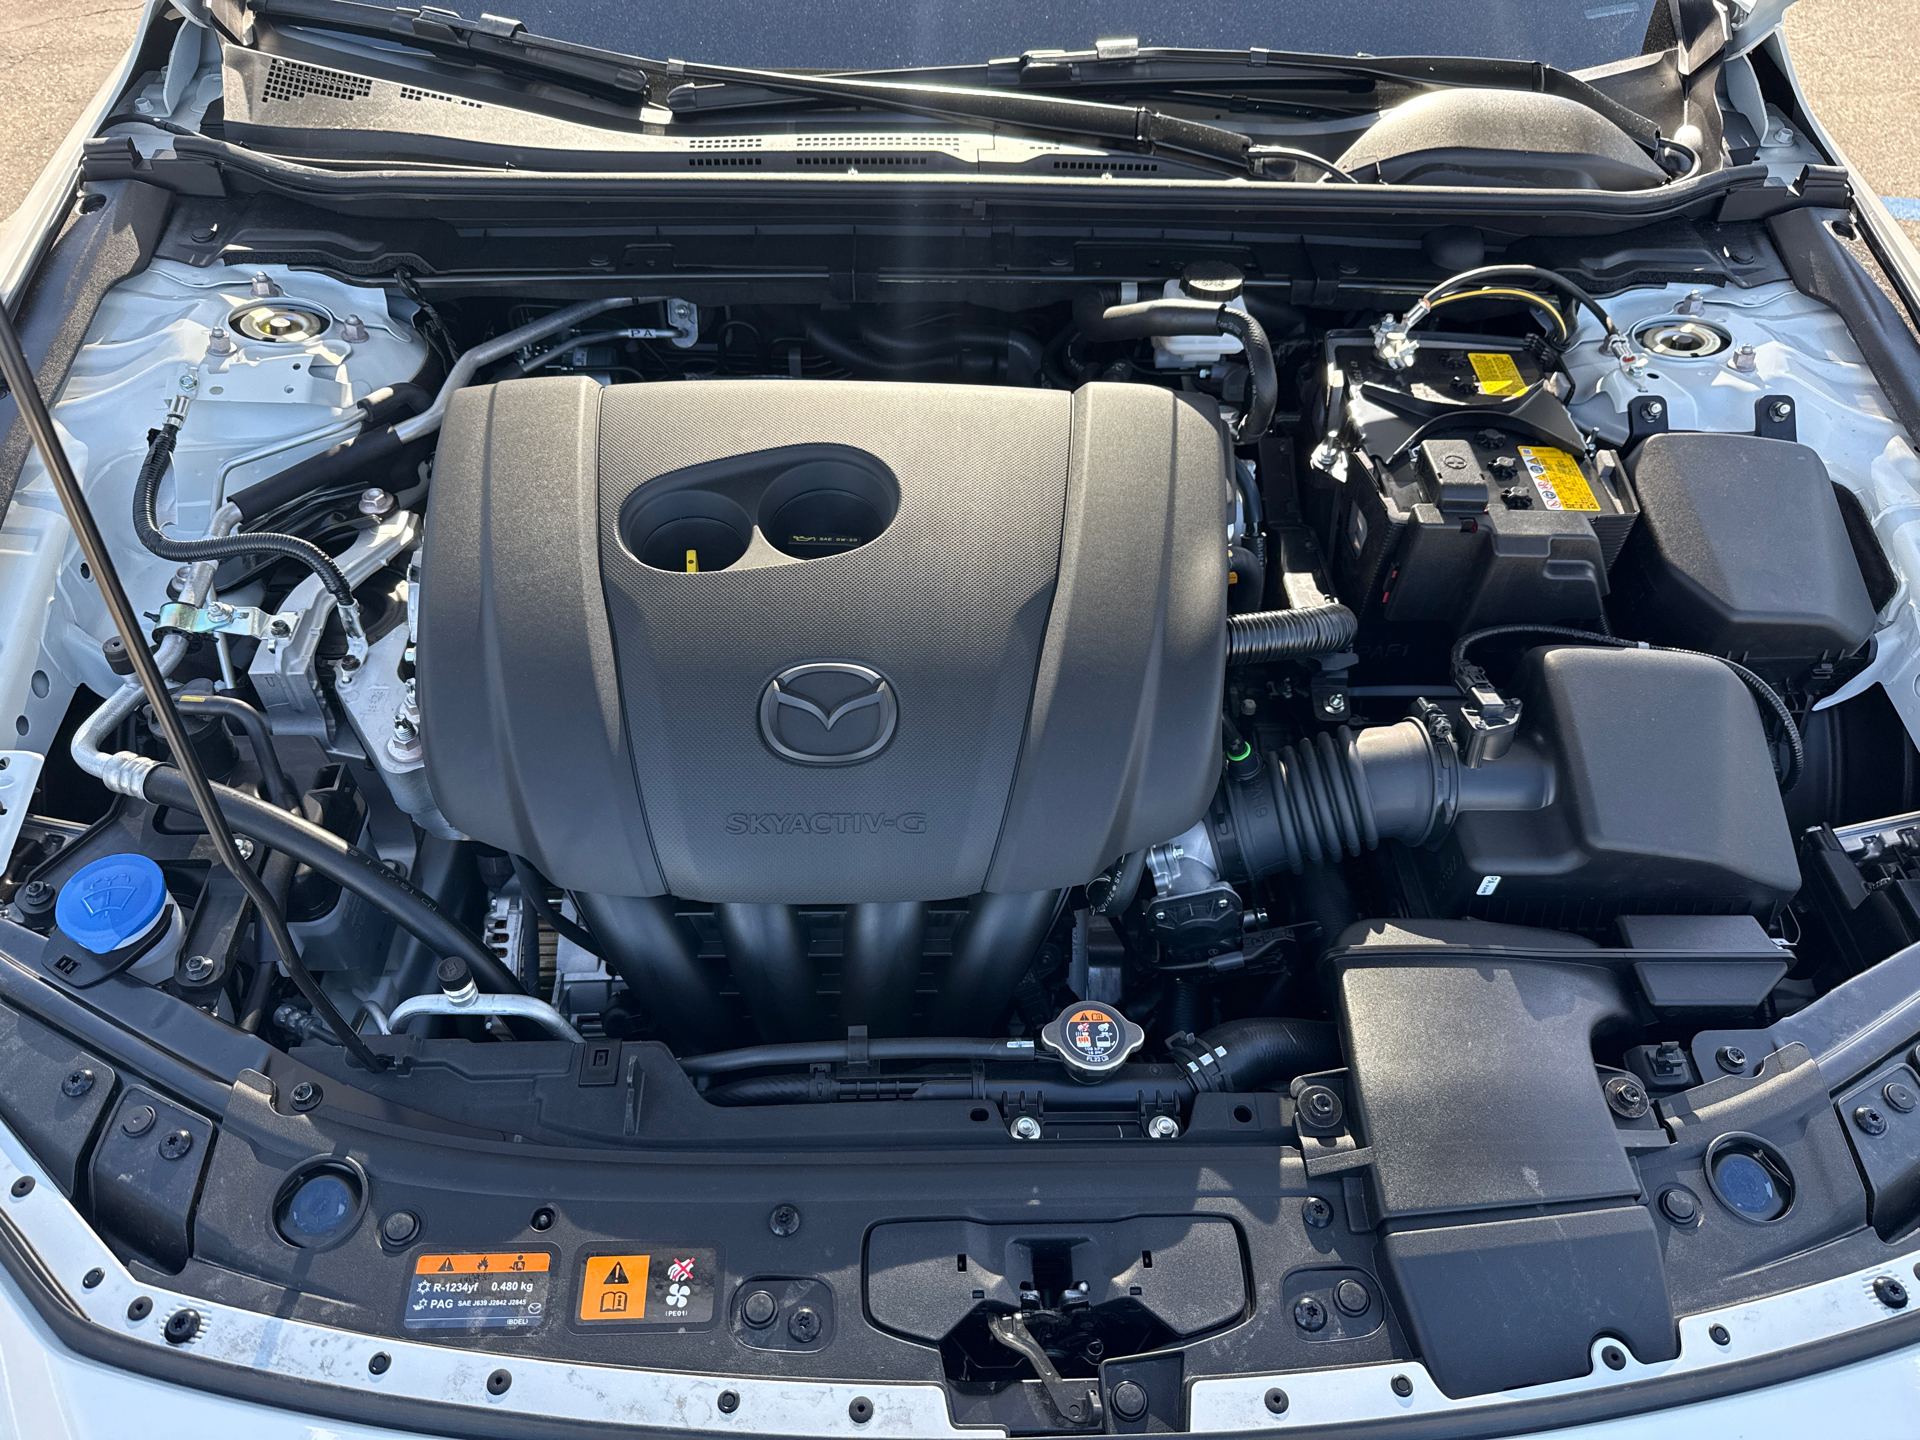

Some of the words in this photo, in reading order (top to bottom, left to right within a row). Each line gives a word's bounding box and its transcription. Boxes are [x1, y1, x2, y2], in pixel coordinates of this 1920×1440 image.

[725, 812, 927, 835] SKYACTIV-G
[433, 1282, 479, 1293] R-1234yf
[491, 1281, 518, 1292] 0.480
[520, 1281, 533, 1292] kg
[430, 1299, 454, 1309] PAG
